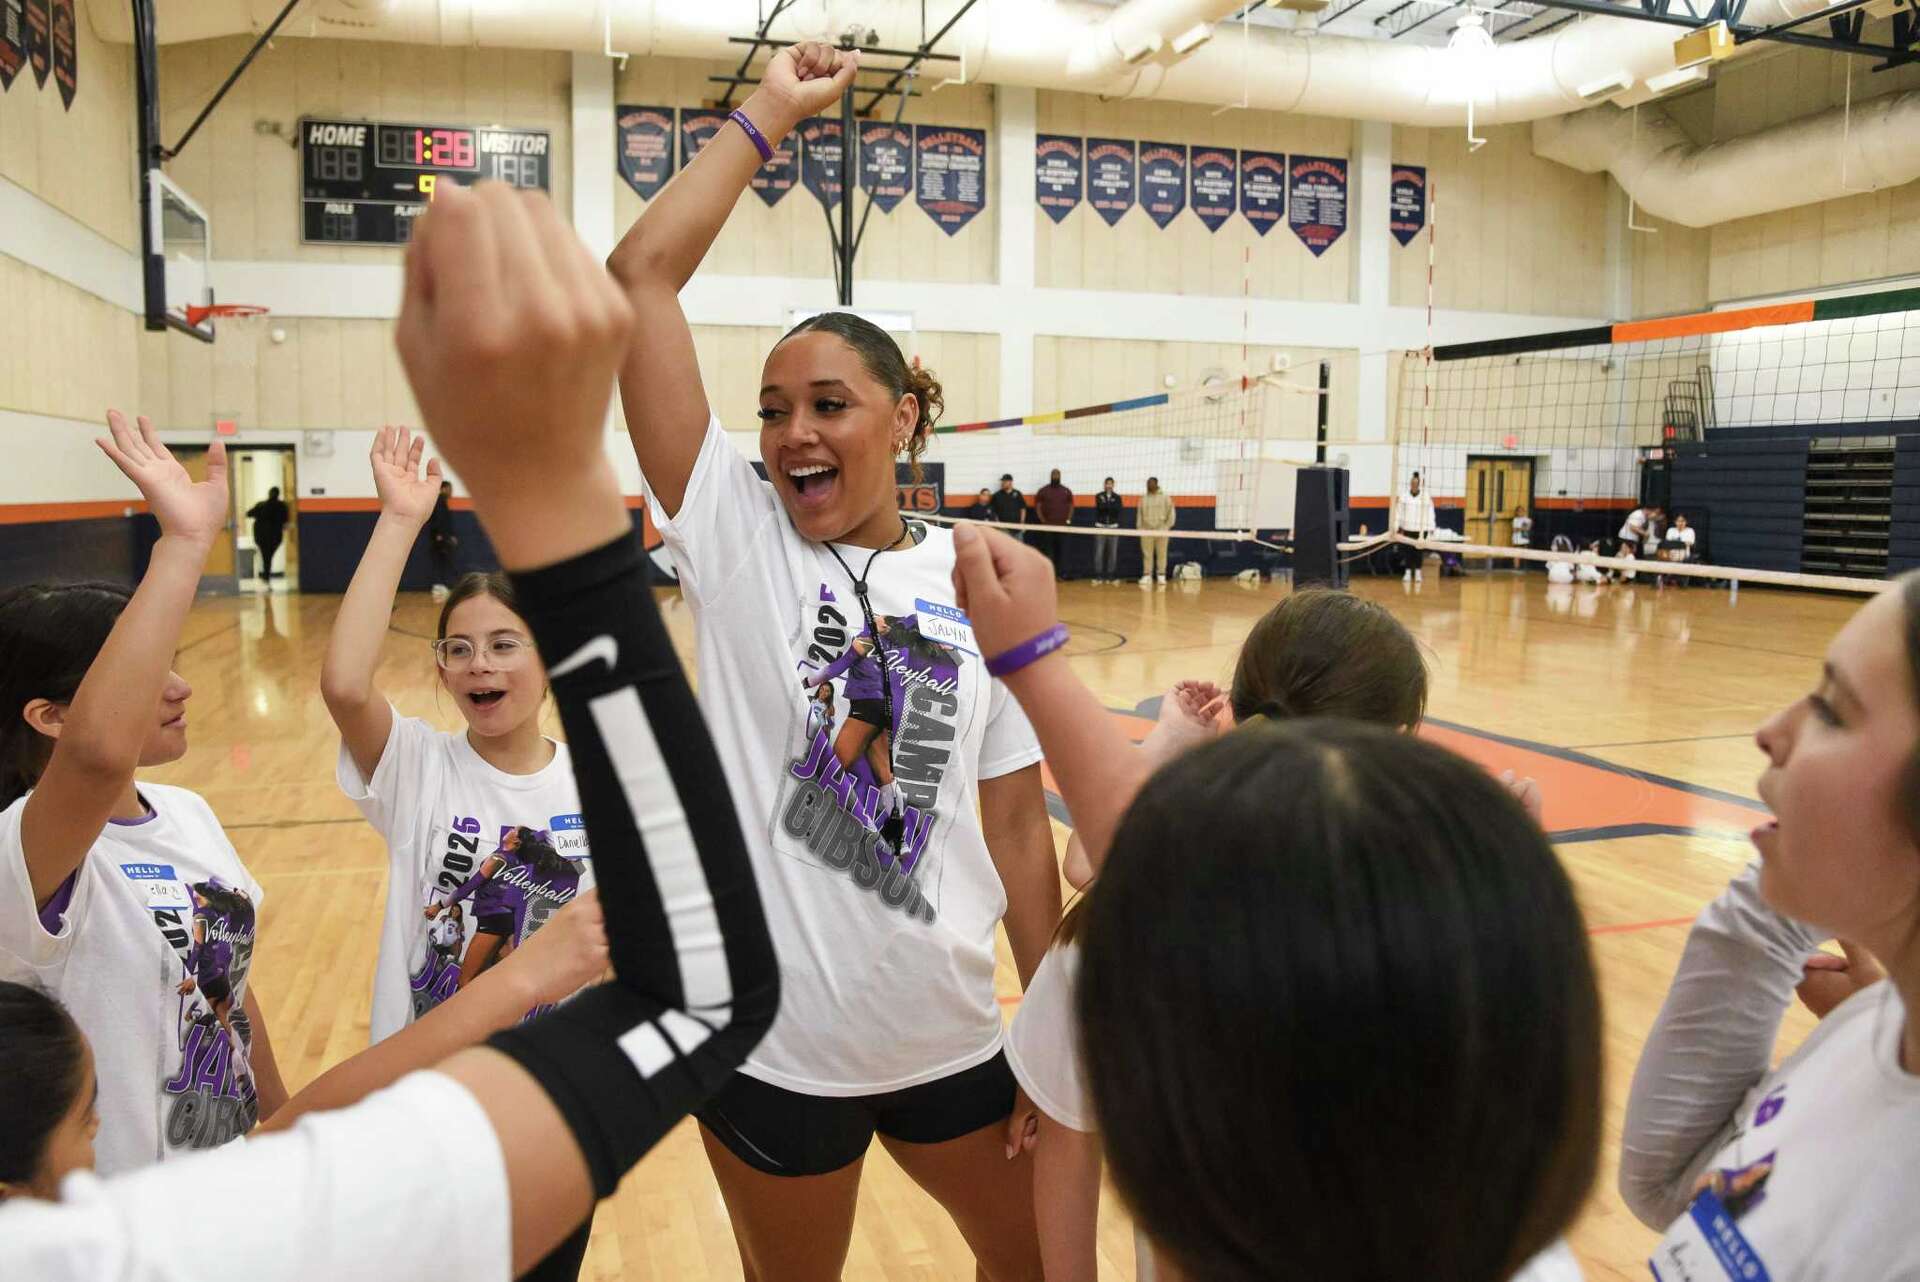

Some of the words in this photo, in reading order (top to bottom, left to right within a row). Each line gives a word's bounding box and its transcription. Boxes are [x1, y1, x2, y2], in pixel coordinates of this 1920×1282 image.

[310, 126, 367, 147] HOME
[481, 132, 548, 155] VISITOR
[929, 604, 961, 619] HELLO
[892, 686, 958, 810] CAMP
[438, 815, 481, 889] 2025
[127, 866, 161, 874] HELLO
[493, 855, 576, 905] Volleyball
